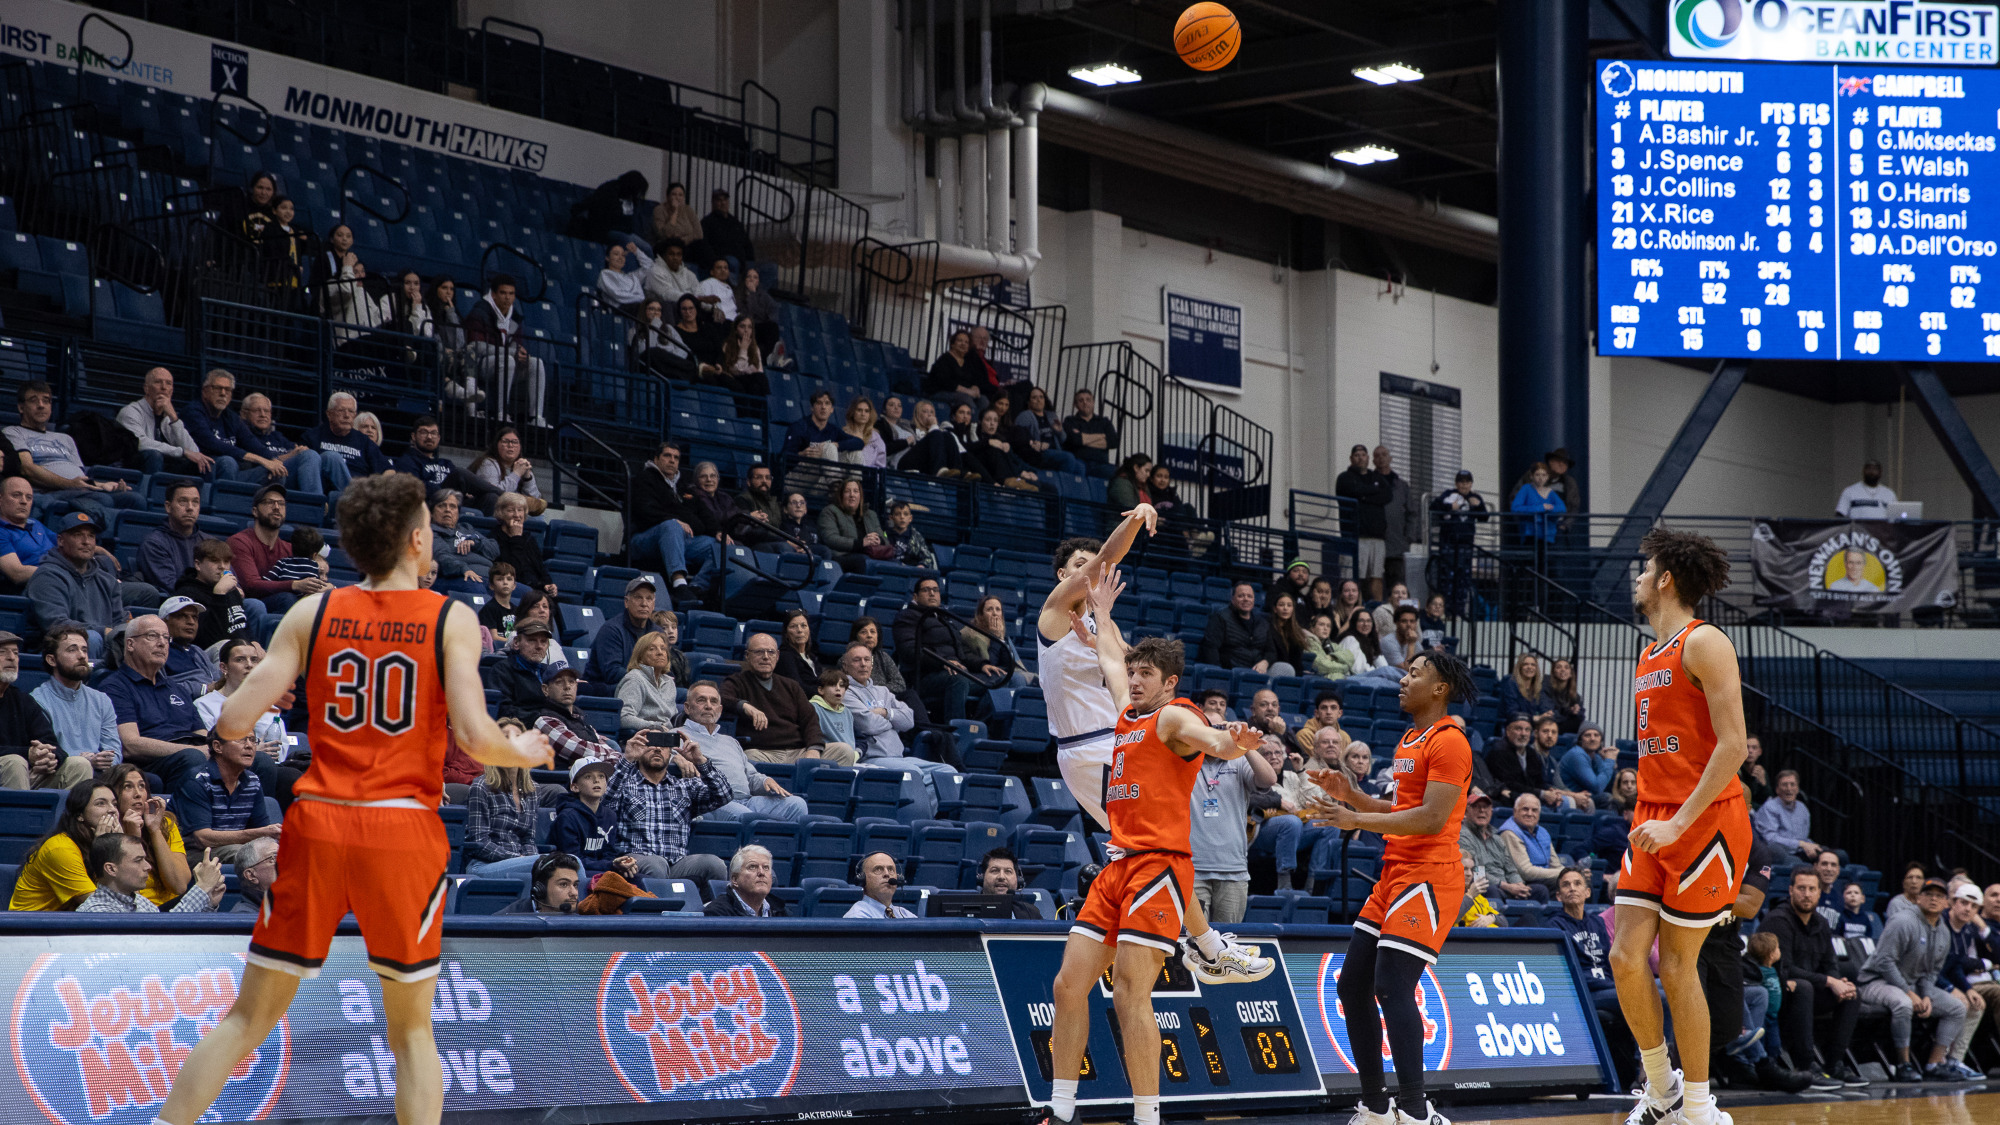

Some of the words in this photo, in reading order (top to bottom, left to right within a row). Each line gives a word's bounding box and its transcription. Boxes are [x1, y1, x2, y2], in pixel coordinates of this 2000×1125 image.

[213, 48, 248, 65] SECTION
[1816, 40, 1889, 57] BANK
[1897, 41, 1993, 60] CENTER
[222, 64, 239, 91] X
[1637, 69, 1743, 93] MONMOUTH
[1873, 75, 1965, 98] CAMPBELL
[1640, 100, 1704, 122] PLAYER
[1761, 103, 1795, 124] PTS
[1800, 104, 1830, 125] FLS
[1878, 106, 1941, 128] PLAYER
[284, 87, 450, 147] MONMOUTH
[448, 124, 547, 171] HAWKS
[1611, 122, 1621, 143] 1
[1639, 124, 1728, 145] A.Bashir
[1735, 126, 1758, 146] Jr.
[1777, 126, 1790, 147] 2
[1809, 127, 1822, 148] 3
[1878, 130, 1995, 151] G.Mokseckas
[1612, 148, 1624, 169] 3
[1640, 149, 1743, 174] J.Spence
[1777, 151, 1790, 173] 6
[1809, 152, 1822, 174] 3
[1850, 154, 1863, 175] 5
[1879, 155, 1968, 176] E.Walsh
[1612, 175, 1633, 196] 13
[1640, 176, 1735, 198] J.Collins
[1769, 178, 1790, 200] 12
[1809, 179, 1822, 200] 3
[1850, 181, 1868, 202] 11
[1878, 182, 1970, 203] O.Harris
[1612, 201, 1633, 223] 21
[1640, 203, 1713, 224] X.Rice
[1766, 205, 1791, 226] 34
[1809, 206, 1822, 227] 3
[1850, 207, 1872, 229] 13
[1878, 209, 1966, 229] J.Sinani
[1612, 228, 1637, 249] 23
[1641, 229, 1735, 250] C.Robinson
[1740, 232, 1759, 251] Jr.
[1809, 232, 1823, 253] 4
[1851, 233, 1876, 255] 30
[1878, 235, 1996, 256] A.Dell'Orso
[1631, 259, 1663, 277] FG%
[1700, 261, 1729, 279] FT%
[1758, 261, 1791, 279] 3P%
[1883, 264, 1915, 282] FG%
[1950, 266, 1980, 283] FT%
[1634, 281, 1659, 302] 44
[1702, 283, 1726, 304] 52
[1765, 284, 1789, 305] 28
[1611, 305, 1639, 323] REB
[1678, 307, 1705, 324] STL
[1741, 308, 1760, 325] TO
[1797, 311, 1825, 328] TOL
[1854, 311, 1882, 329] REB
[1920, 312, 1947, 330] STL
[1614, 327, 1636, 348] 37
[1680, 328, 1703, 350] 15
[1747, 329, 1761, 351] 9
[1805, 330, 1818, 352] 0
[1855, 333, 1879, 354] 40
[1927, 334, 1940, 355] 3
[1808, 531, 1880, 590] NEWMAN'S
[1878, 549, 1904, 593] OWN
[327, 618, 427, 644] DELL'ORSO
[324, 648, 418, 736] 30
[1640, 698, 1649, 730] 5
[1106, 783, 1140, 803] AMELS
[338, 980, 375, 1022] a
[430, 961, 493, 1021] ub
[833, 974, 863, 1014] a
[873, 960, 950, 1015] sub
[1466, 972, 1489, 1005] a
[1492, 961, 1545, 1006] sub
[48, 968, 239, 1048] Jersey
[625, 965, 766, 1033] Jersey
[1027, 1003, 1056, 1027] HO
[1154, 1012, 1181, 1029] RIOD
[1236, 1001, 1281, 1023] GUEST
[1475, 1012, 1565, 1057] above
[649, 1013, 780, 1093] Mike's
[841, 1024, 972, 1078] above
[1163, 1040, 1181, 1077] 2
[1256, 1032, 1296, 1069] 87
[1454, 1081, 1490, 1089] DAKTRONICS
[798, 1110, 853, 1120] DAKTRONICS
